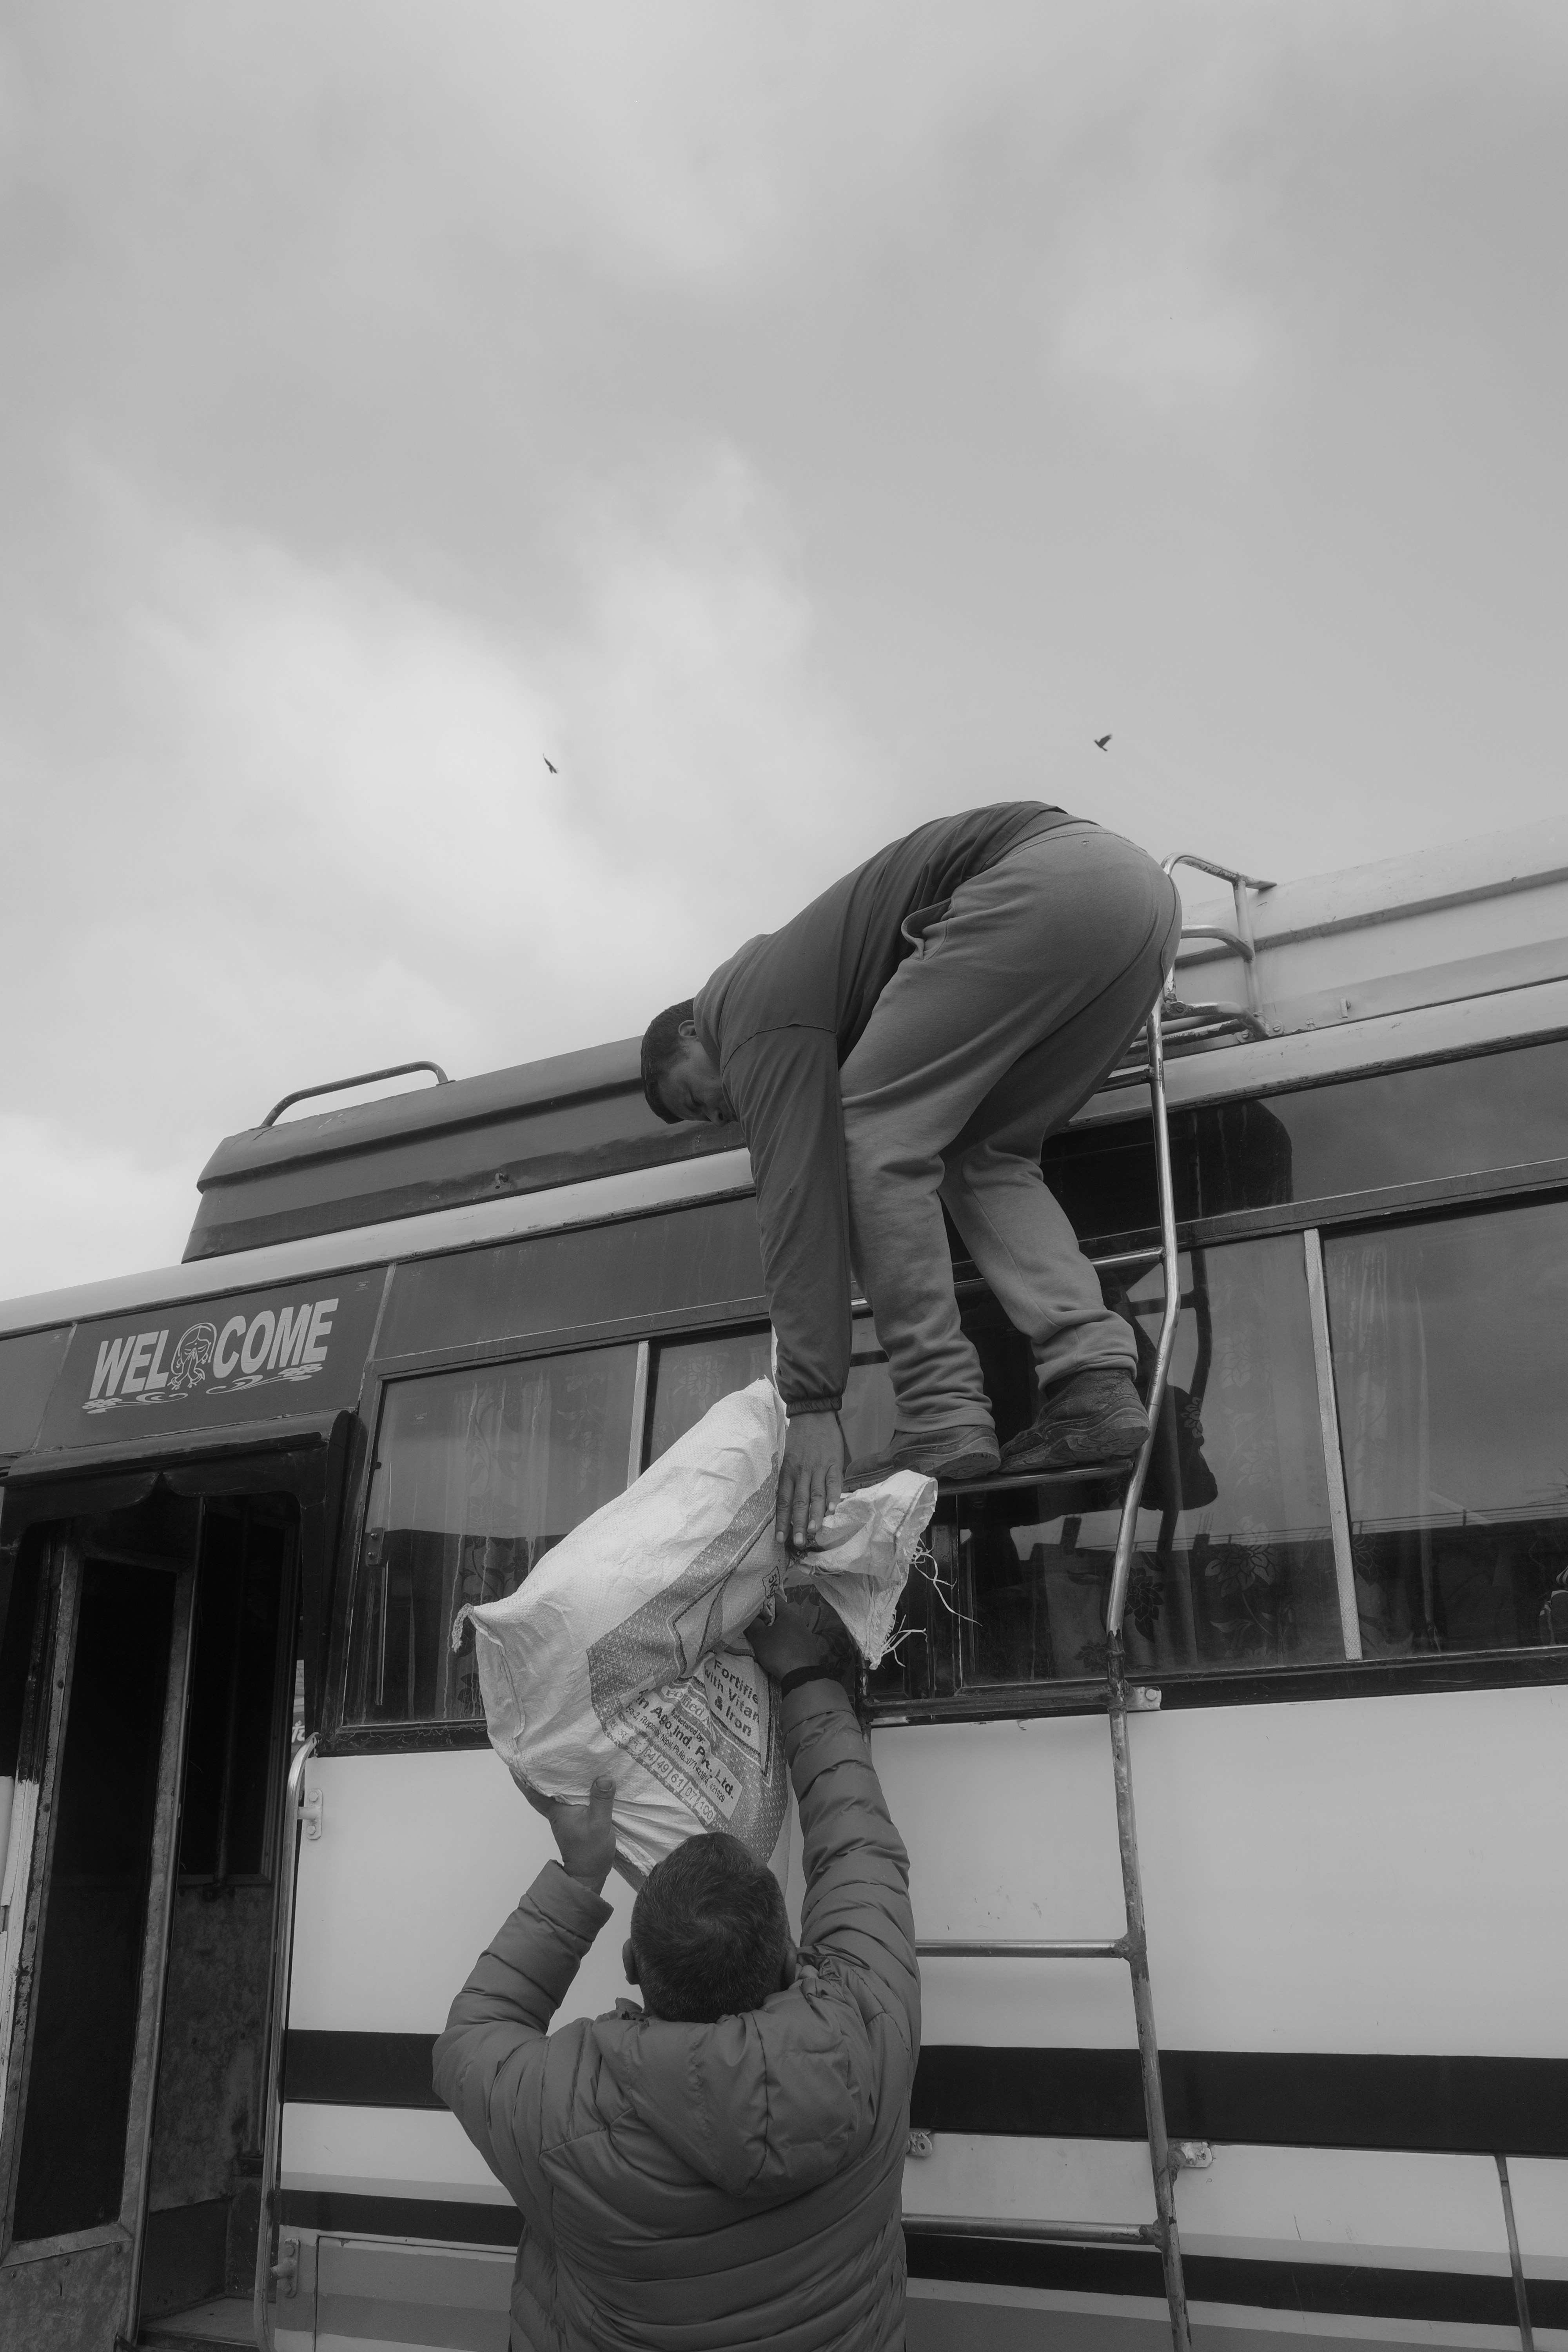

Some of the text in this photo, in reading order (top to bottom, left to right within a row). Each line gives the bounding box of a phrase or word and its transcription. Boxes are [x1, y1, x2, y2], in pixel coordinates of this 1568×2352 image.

[714, 1659, 758, 1704] Fortifie
[714, 1695, 723, 1711] &
[725, 1705, 752, 1737] Iron
[673, 1725, 693, 1749] Ind.
[715, 1769, 733, 1799] Ltd.
[657, 1759, 670, 1774] 49
[670, 1773, 684, 1787] 61
[685, 1787, 697, 1800] 07
[699, 1801, 713, 1820] 100
[709, 1783, 725, 1802] 421029
